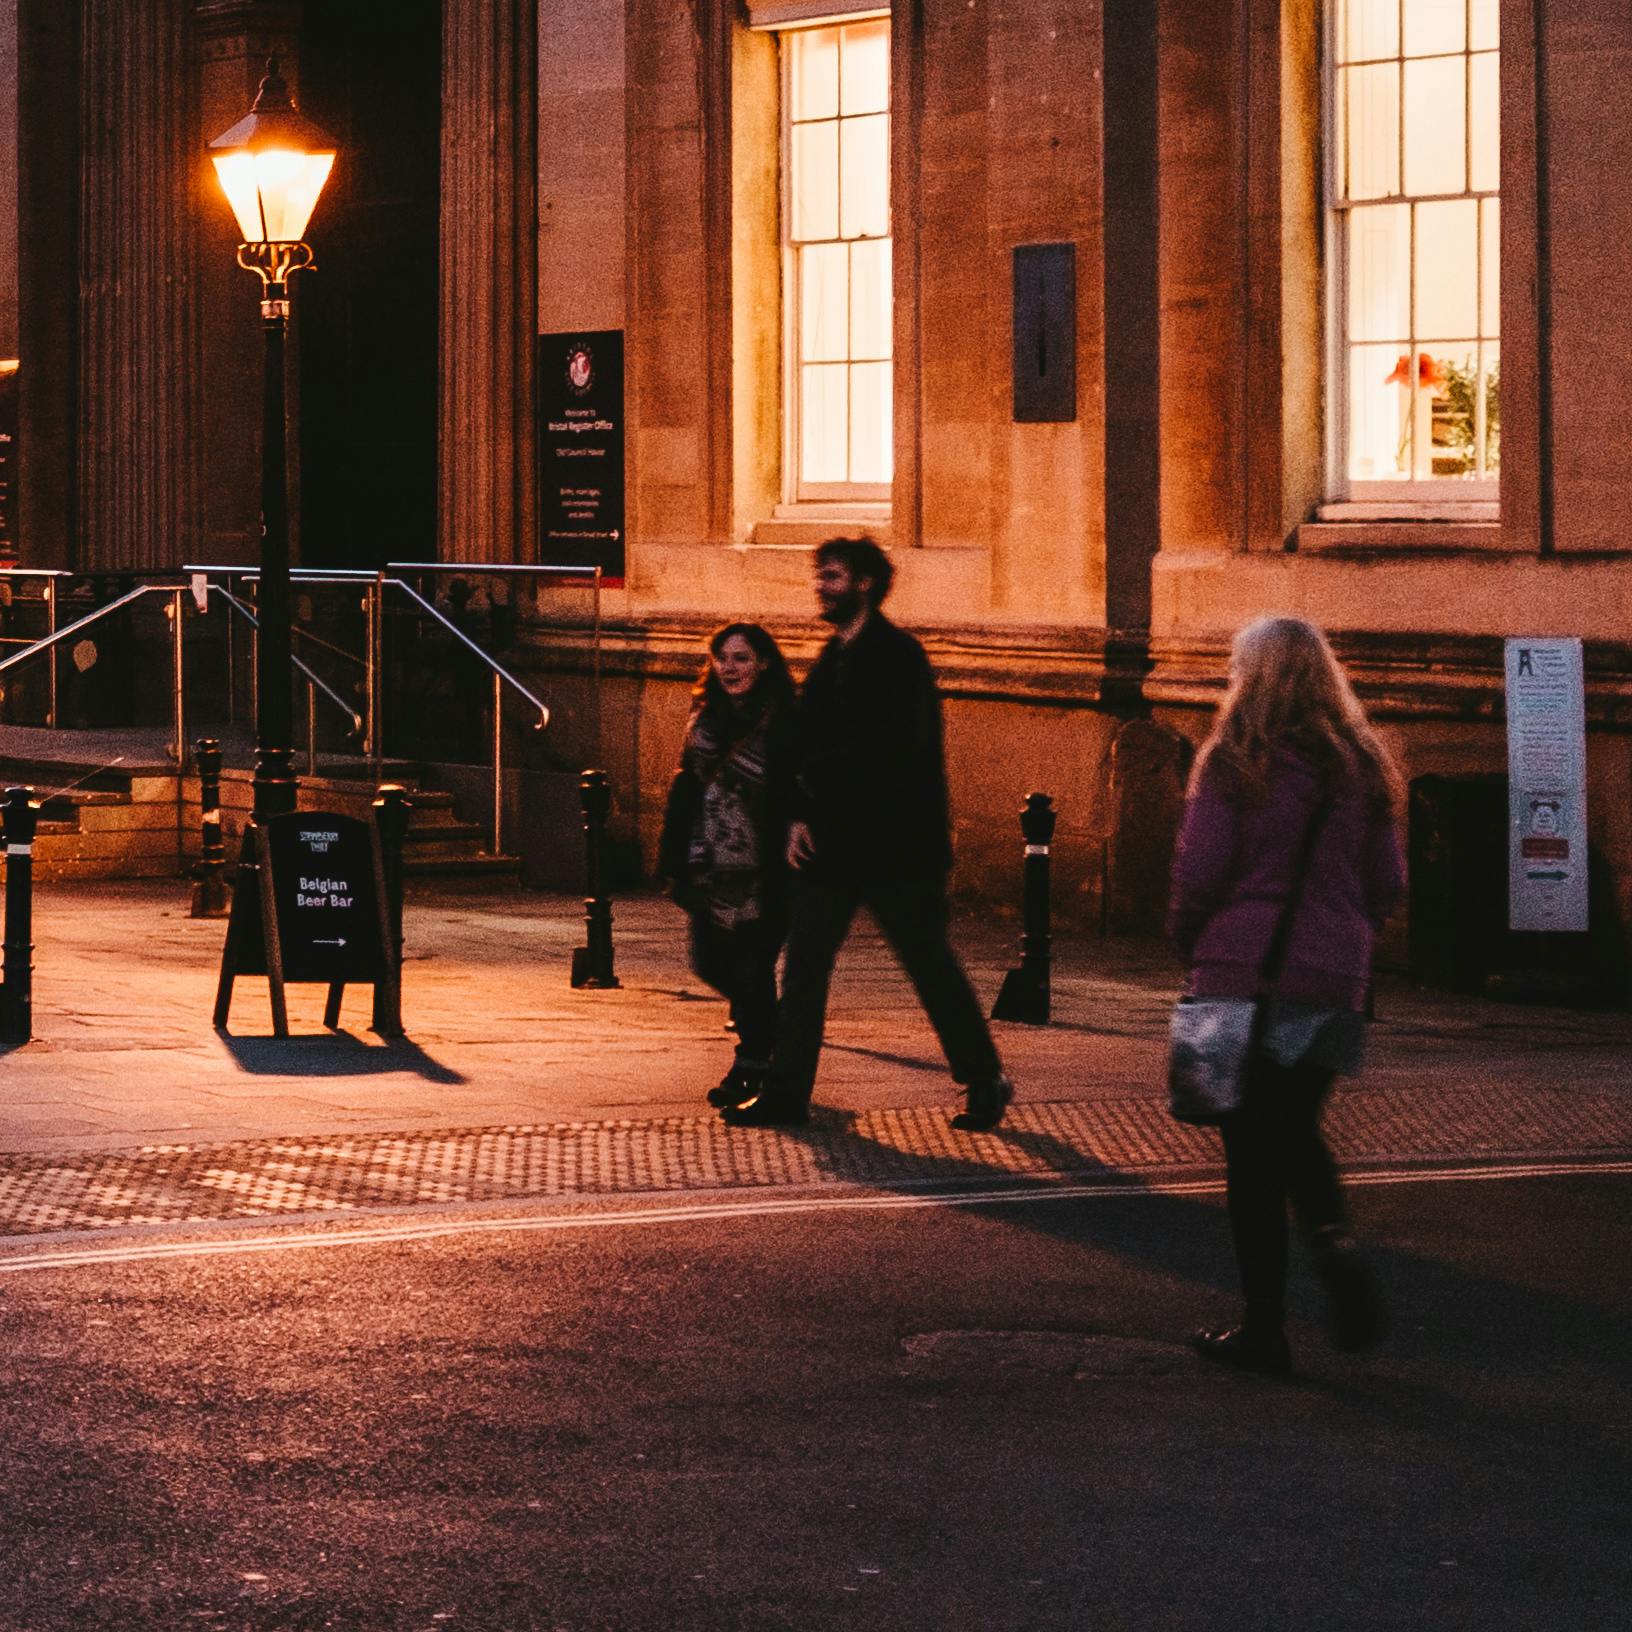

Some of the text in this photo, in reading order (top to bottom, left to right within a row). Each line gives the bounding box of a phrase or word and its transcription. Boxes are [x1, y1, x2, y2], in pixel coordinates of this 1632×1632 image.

[299, 877, 348, 894] Belgian
[297, 894, 354, 908] Beer Bar
